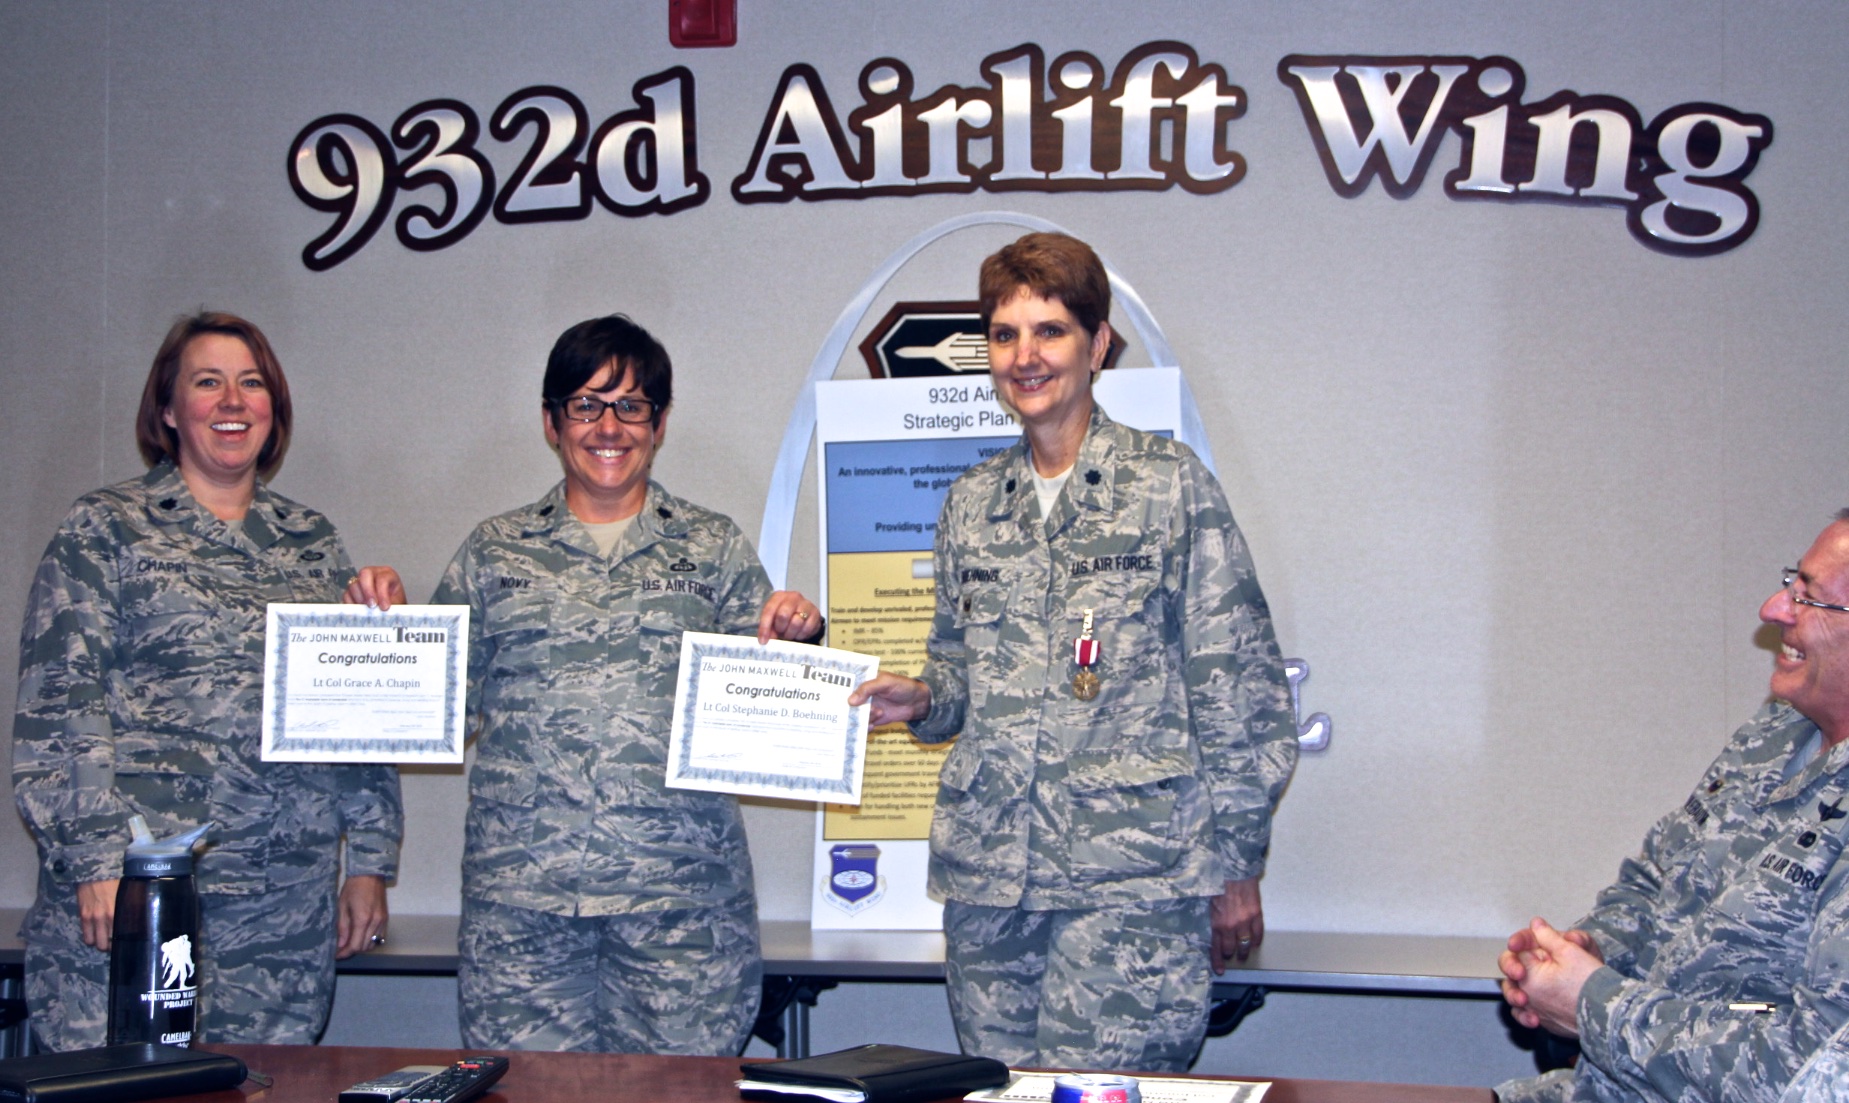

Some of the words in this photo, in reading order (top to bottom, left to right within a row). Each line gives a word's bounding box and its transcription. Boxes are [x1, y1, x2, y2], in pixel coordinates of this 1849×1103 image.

[288, 66, 710, 270] 932d
[731, 41, 1247, 203] Airlift
[1278, 54, 1773, 256] Wing
[928, 387, 968, 404] 932d
[903, 411, 974, 431] Strategic
[979, 411, 1014, 427] Plan
[838, 467, 852, 477] An
[854, 465, 908, 477] innovative,
[913, 480, 929, 489] the
[875, 522, 923, 533] Providing
[136, 559, 188, 574] CHAPIN
[1093, 557, 1113, 572] AIR
[1115, 555, 1153, 571] FORCE
[665, 580, 686, 592] AIR
[688, 581, 716, 602] FORCE
[290, 632, 308, 643] The
[309, 633, 338, 643] JOHN
[340, 633, 392, 643] MAXWELL
[393, 626, 446, 643] Team
[318, 652, 418, 666] Congratulations
[702, 661, 717, 672] The
[719, 663, 745, 674] JOHN
[748, 666, 797, 679] MAXWELL
[801, 663, 852, 688] Team
[312, 678, 324, 688] Lt
[325, 678, 342, 688] Col
[344, 678, 373, 688] Grace
[374, 678, 385, 688] A.
[386, 678, 421, 690] Chapin
[725, 682, 821, 702] Congratulations
[703, 702, 713, 712] Lt
[715, 702, 731, 713] Col
[732, 703, 779, 719] Stephanie
[780, 708, 791, 718] D.
[792, 709, 839, 723] Boehning
[1785, 862, 1828, 891] FORC
[140, 992, 181, 1002] WOUNDED
[163, 999, 193, 1009] PROJECT
